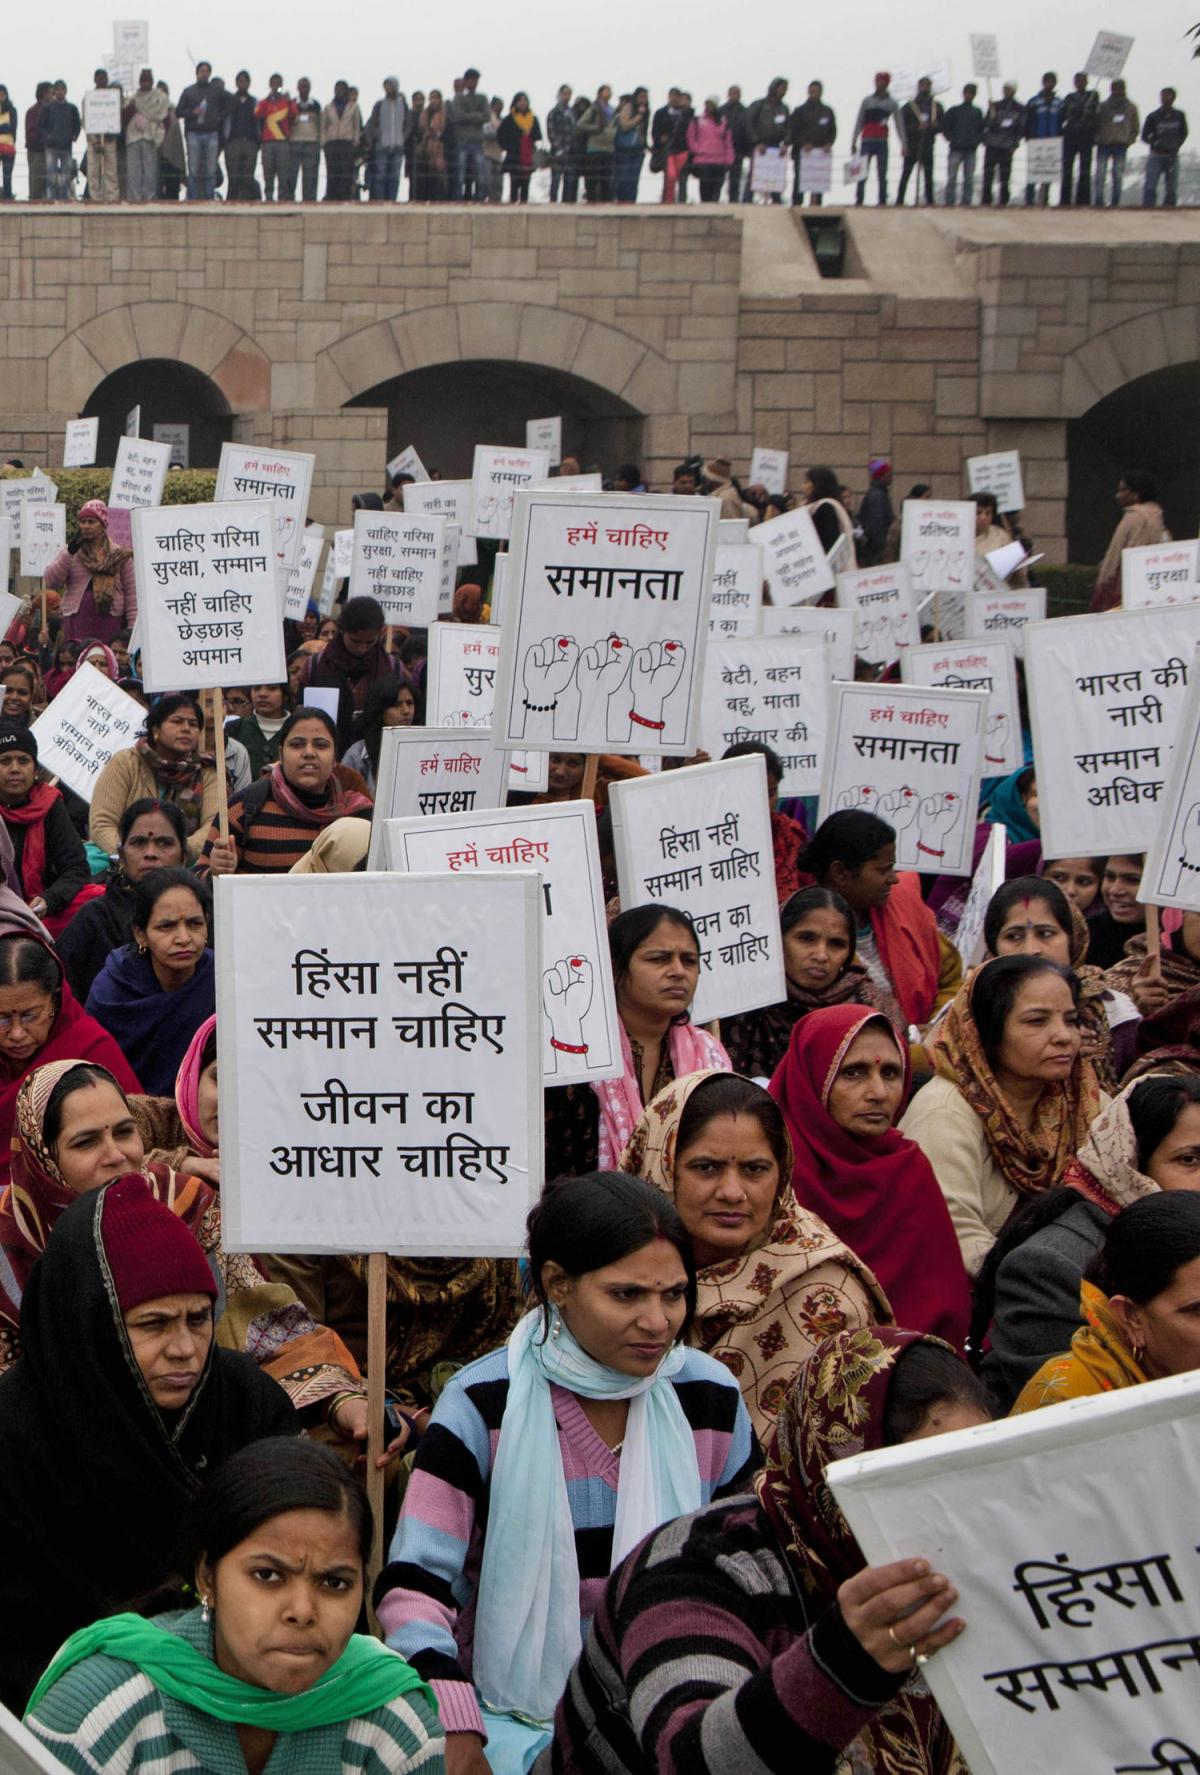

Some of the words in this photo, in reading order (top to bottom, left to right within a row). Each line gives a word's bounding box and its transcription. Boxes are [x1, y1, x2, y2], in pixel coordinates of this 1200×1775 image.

[243, 460, 259, 473] हमें
[262, 461, 291, 477] चाहिए
[490, 471, 531, 485] सम्मान
[233, 477, 296, 500] समानता
[155, 528, 205, 553] चाहिए
[212, 526, 260, 548] गरिमा
[367, 526, 399, 543] चाहिए
[402, 528, 434, 543] गरिमा
[567, 521, 599, 546] हमें
[605, 523, 670, 551] चाहिए
[919, 521, 960, 537] प्रतिष्ठा
[400, 546, 437, 559] सम्मान
[152, 559, 205, 584] सुरक्षा,
[211, 556, 267, 575] सम्मान
[368, 566, 390, 580] नहीं
[392, 567, 423, 583] चाहिए
[713, 569, 737, 586] नहीं
[1146, 569, 1188, 591] सुरक्षा
[544, 565, 684, 601] समानता
[165, 591, 197, 616] नहीं
[202, 589, 252, 613] चाहिए
[712, 591, 750, 608] चाहिए
[857, 588, 899, 607] सम्मान
[177, 618, 244, 643] छेड़छाड़
[182, 647, 242, 666] अपमान
[463, 640, 482, 657] हमें
[765, 665, 801, 684] बहन
[933, 657, 949, 673] हमें
[955, 655, 988, 669] चाहिए
[1075, 670, 1142, 697] भारत
[1152, 657, 1188, 688] की
[763, 693, 800, 710] माता
[1107, 694, 1163, 728] नारी
[113, 719, 131, 736] की
[870, 705, 895, 723] हमें
[900, 707, 949, 730] चाहिए
[60, 718, 95, 752] सम्मान
[95, 747, 113, 766] की
[722, 726, 778, 745] परिवार
[785, 722, 808, 743] की
[853, 734, 961, 765] समानता
[1074, 747, 1160, 774] सम्मान
[420, 754, 439, 775] हमें
[444, 752, 482, 774] चाहिए
[659, 825, 700, 860] हिंसा
[706, 812, 740, 846] नहीं
[446, 842, 479, 872] हमें
[485, 838, 551, 865] चाहिए
[644, 865, 703, 899] सम्मान
[709, 848, 760, 882] चाहिए
[728, 904, 751, 928] का
[719, 932, 770, 966] चाहिए
[291, 948, 380, 999] हिंसा
[394, 947, 469, 997] नहीं
[253, 1016, 378, 1049] सम्मान
[392, 1002, 507, 1054] चाहिए
[300, 1078, 409, 1125] जीवन
[423, 1092, 476, 1124] का
[269, 1146, 383, 1179] आधार
[397, 1132, 511, 1185] चाहिए
[1013, 1553, 1185, 1631] हिंसा
[983, 1635, 1200, 1714] सम्मान
